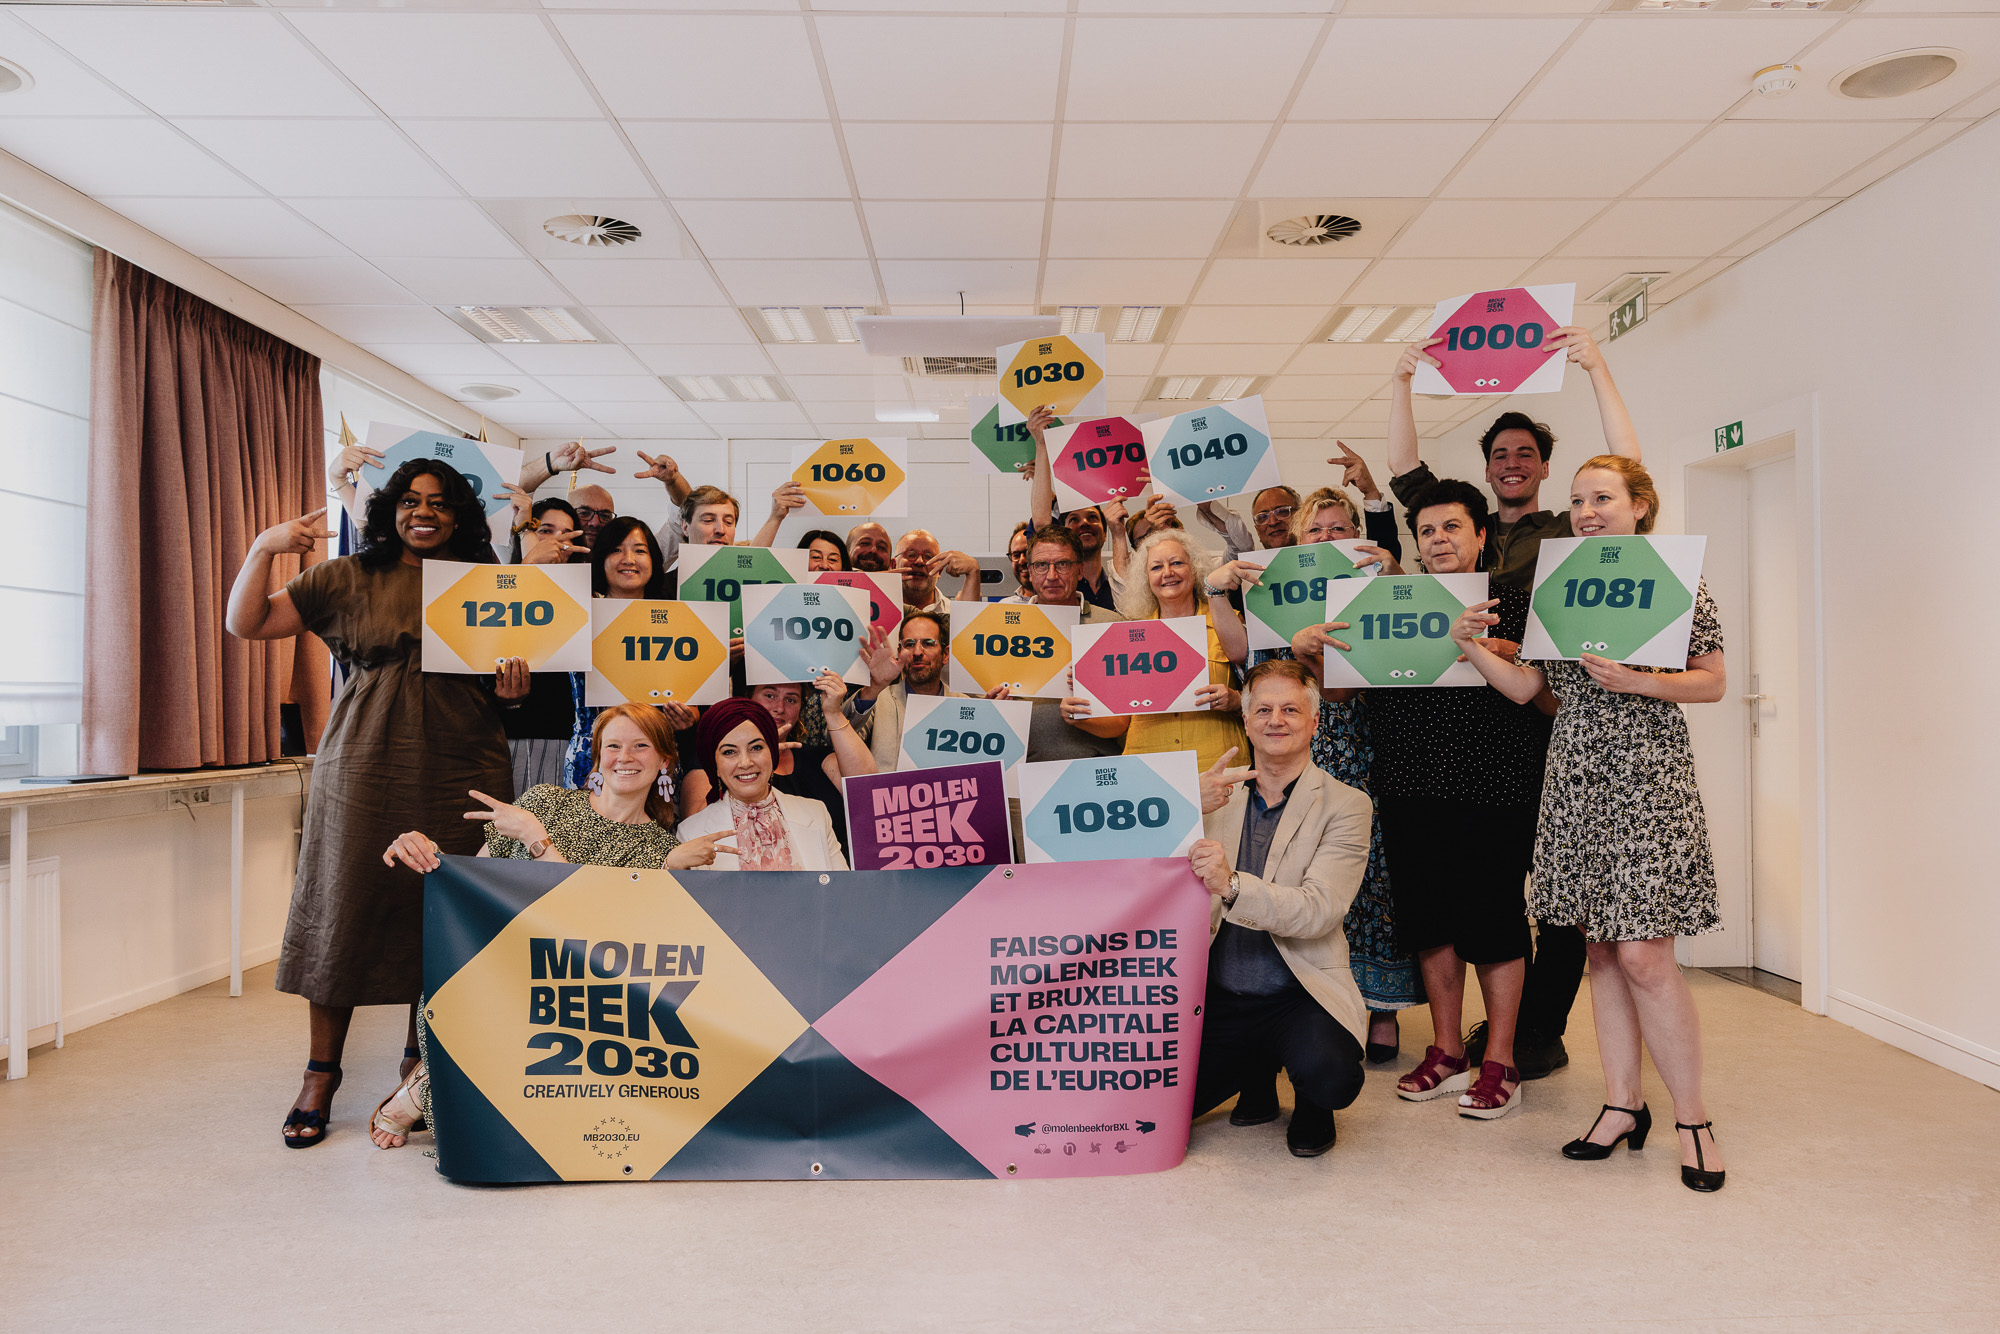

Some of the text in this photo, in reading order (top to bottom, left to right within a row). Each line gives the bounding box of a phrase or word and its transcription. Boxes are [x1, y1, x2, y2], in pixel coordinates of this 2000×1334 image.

[1446, 323, 1543, 351] 1000
[1014, 361, 1084, 388] 1030
[994, 423, 1050, 442] 119
[1072, 443, 1145, 472] 1070
[1167, 433, 1248, 470] 1040
[810, 463, 885, 482] 1060
[1601, 551, 1620, 559] BEEK
[703, 579, 783, 602] 10
[1269, 574, 1352, 606] 108
[1564, 578, 1655, 609] 1081
[461, 601, 554, 627] 1210
[1359, 612, 1449, 640] 1150
[770, 617, 853, 641] 1090
[621, 636, 698, 661] 1170
[972, 634, 1054, 658] 1083
[1102, 651, 1177, 676] 1140
[926, 728, 1005, 755] 1200
[1096, 772, 1117, 781] BEEK
[872, 777, 978, 816] MOLEN
[875, 799, 984, 843] BEEK
[1053, 797, 1170, 834] 1080
[878, 845, 985, 870] 2030
[990, 929, 1177, 957] FAISONS DE
[529, 937, 705, 980] MOLEN
[990, 957, 1178, 985] MOLENBEEK
[990, 985, 1179, 1013] ET BRUXELLES
[529, 980, 700, 1049] BEEK
[990, 1013, 1179, 1038] LA CAPITALE
[525, 1032, 700, 1080] 2030
[990, 1039, 1178, 1063] CULTURELLE
[523, 1084, 700, 1100] CREATIVELY GENEROUS
[990, 1067, 1178, 1091] DE L’EUROPE
[1042, 1123, 1129, 1134] @molenbeekforBXL
